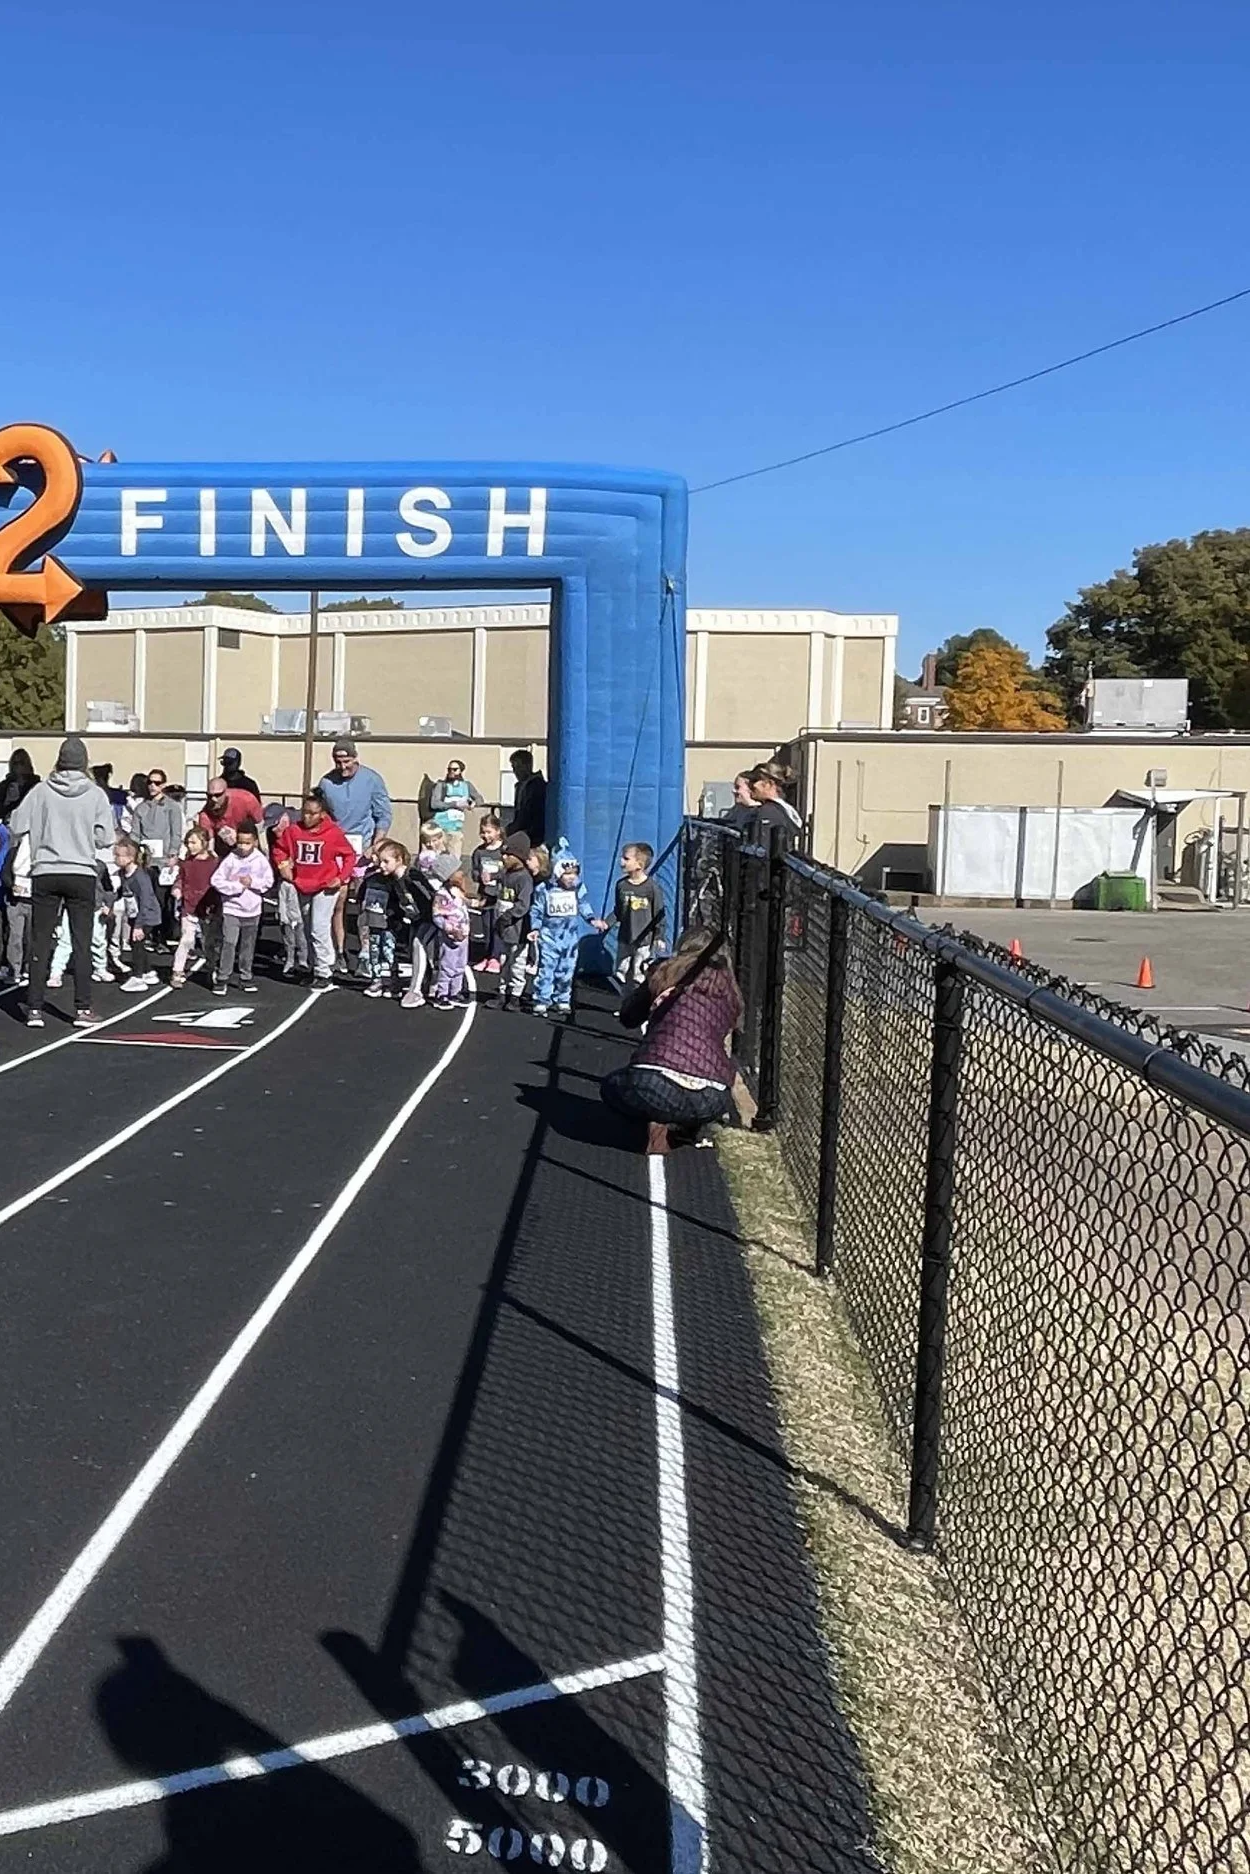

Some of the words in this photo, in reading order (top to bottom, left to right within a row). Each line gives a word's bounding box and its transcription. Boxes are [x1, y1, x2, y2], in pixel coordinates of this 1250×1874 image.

[120, 486, 547, 558] FINISH
[296, 840, 325, 865] H
[550, 902, 575, 914] DASH
[151, 1007, 255, 1028] 4
[458, 1759, 610, 1807] 3000
[445, 1819, 609, 1873] 5000
